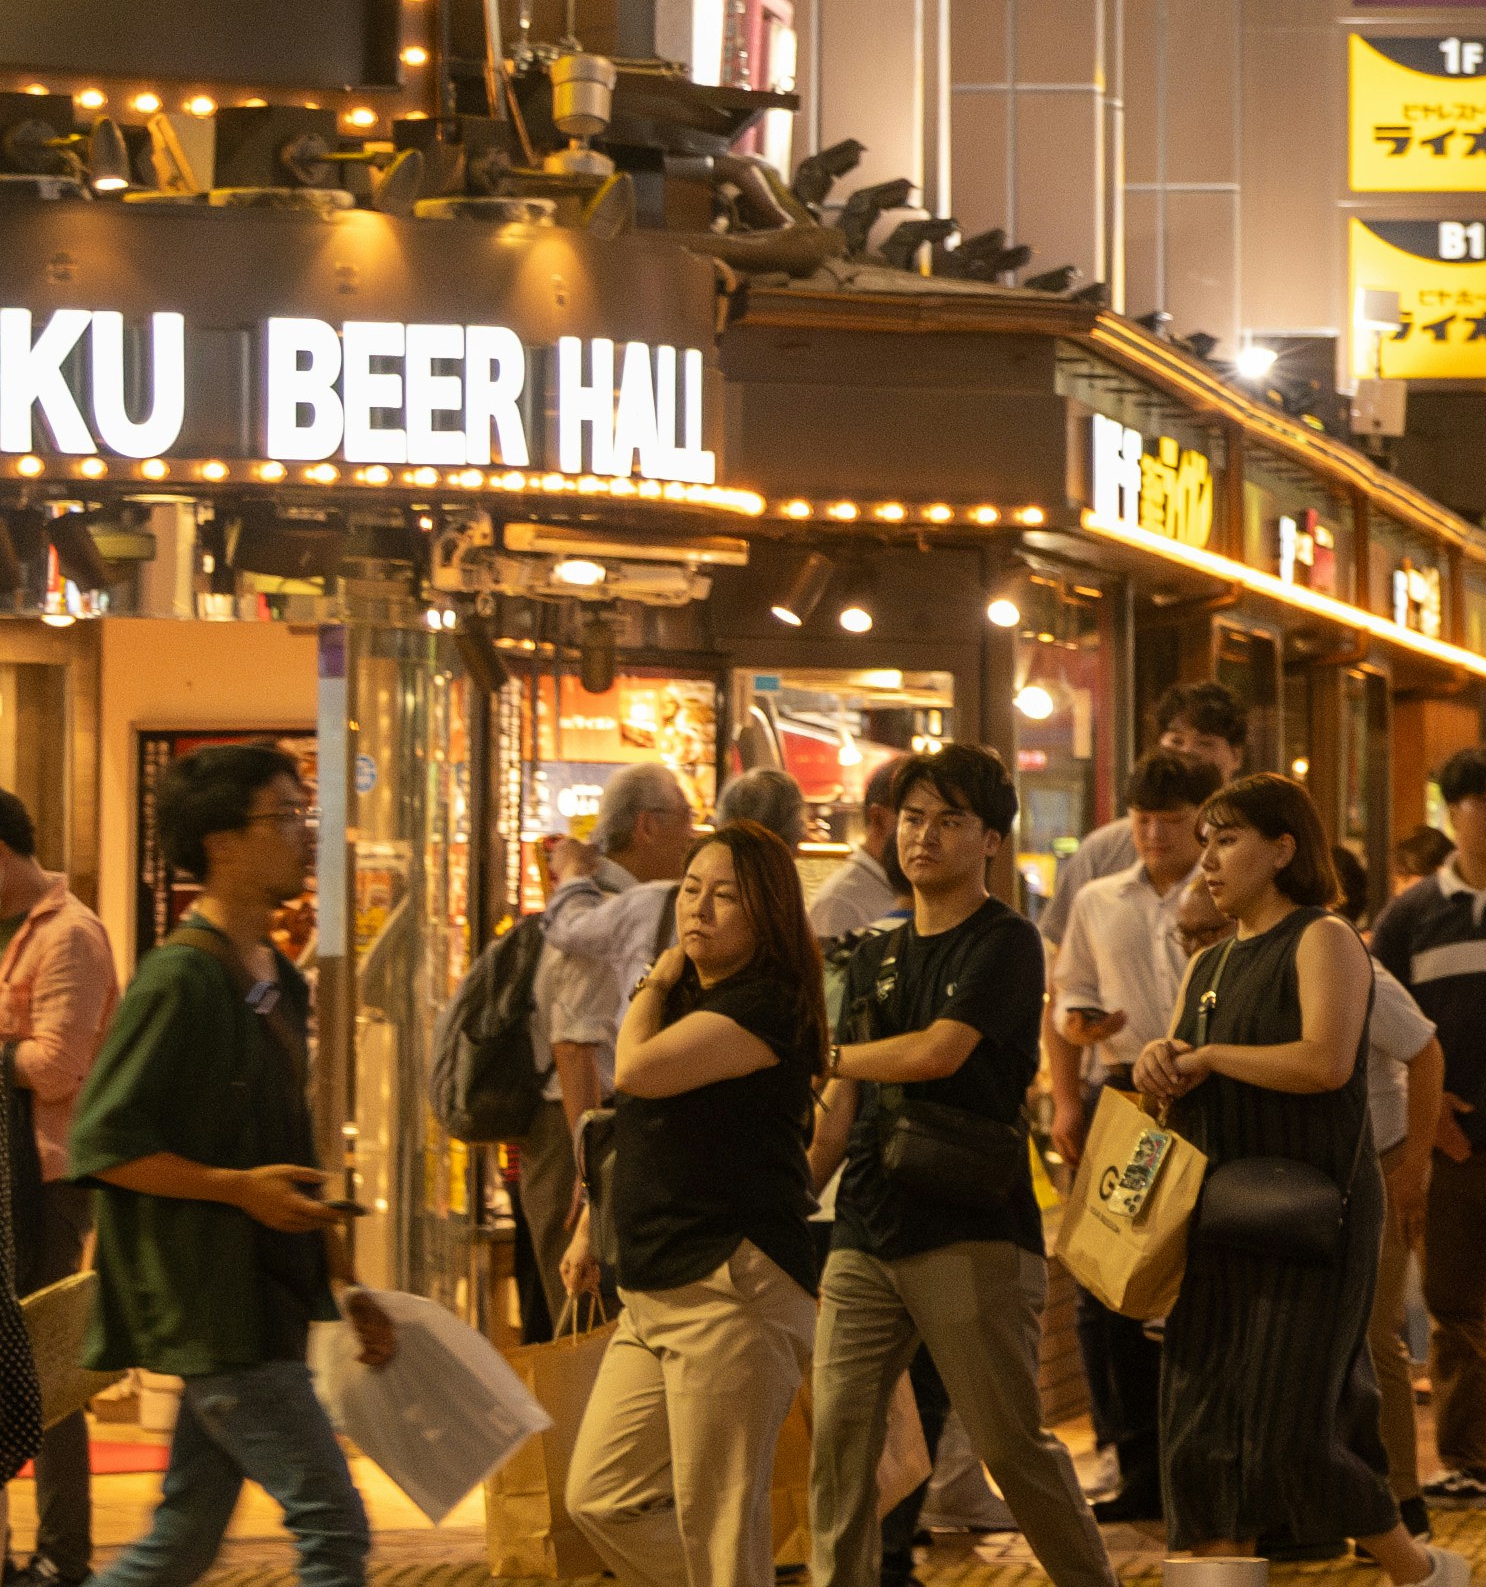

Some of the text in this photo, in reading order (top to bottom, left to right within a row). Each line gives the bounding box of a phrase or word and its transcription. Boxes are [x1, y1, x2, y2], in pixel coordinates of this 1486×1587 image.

[1438, 36, 1485, 75] 1F
[1438, 220, 1485, 260] B1
[267, 317, 530, 467] BEER
[558, 335, 716, 484] HALL
